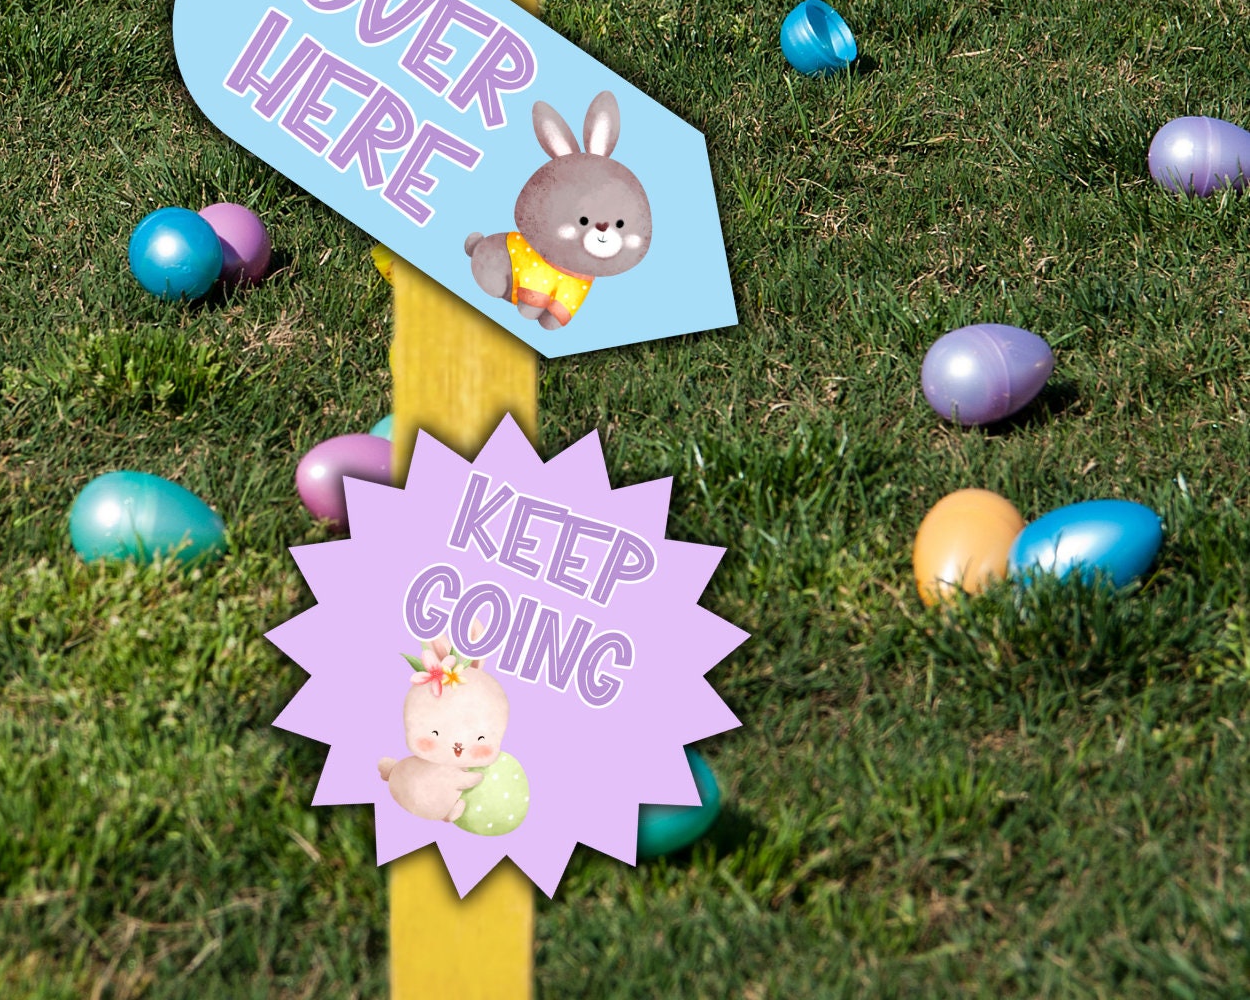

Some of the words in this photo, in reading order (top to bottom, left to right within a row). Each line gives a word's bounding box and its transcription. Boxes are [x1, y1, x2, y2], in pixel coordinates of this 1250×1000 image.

[225, 9, 482, 225] HERE
[448, 472, 655, 606] KEEP
[404, 564, 634, 707] GOING
